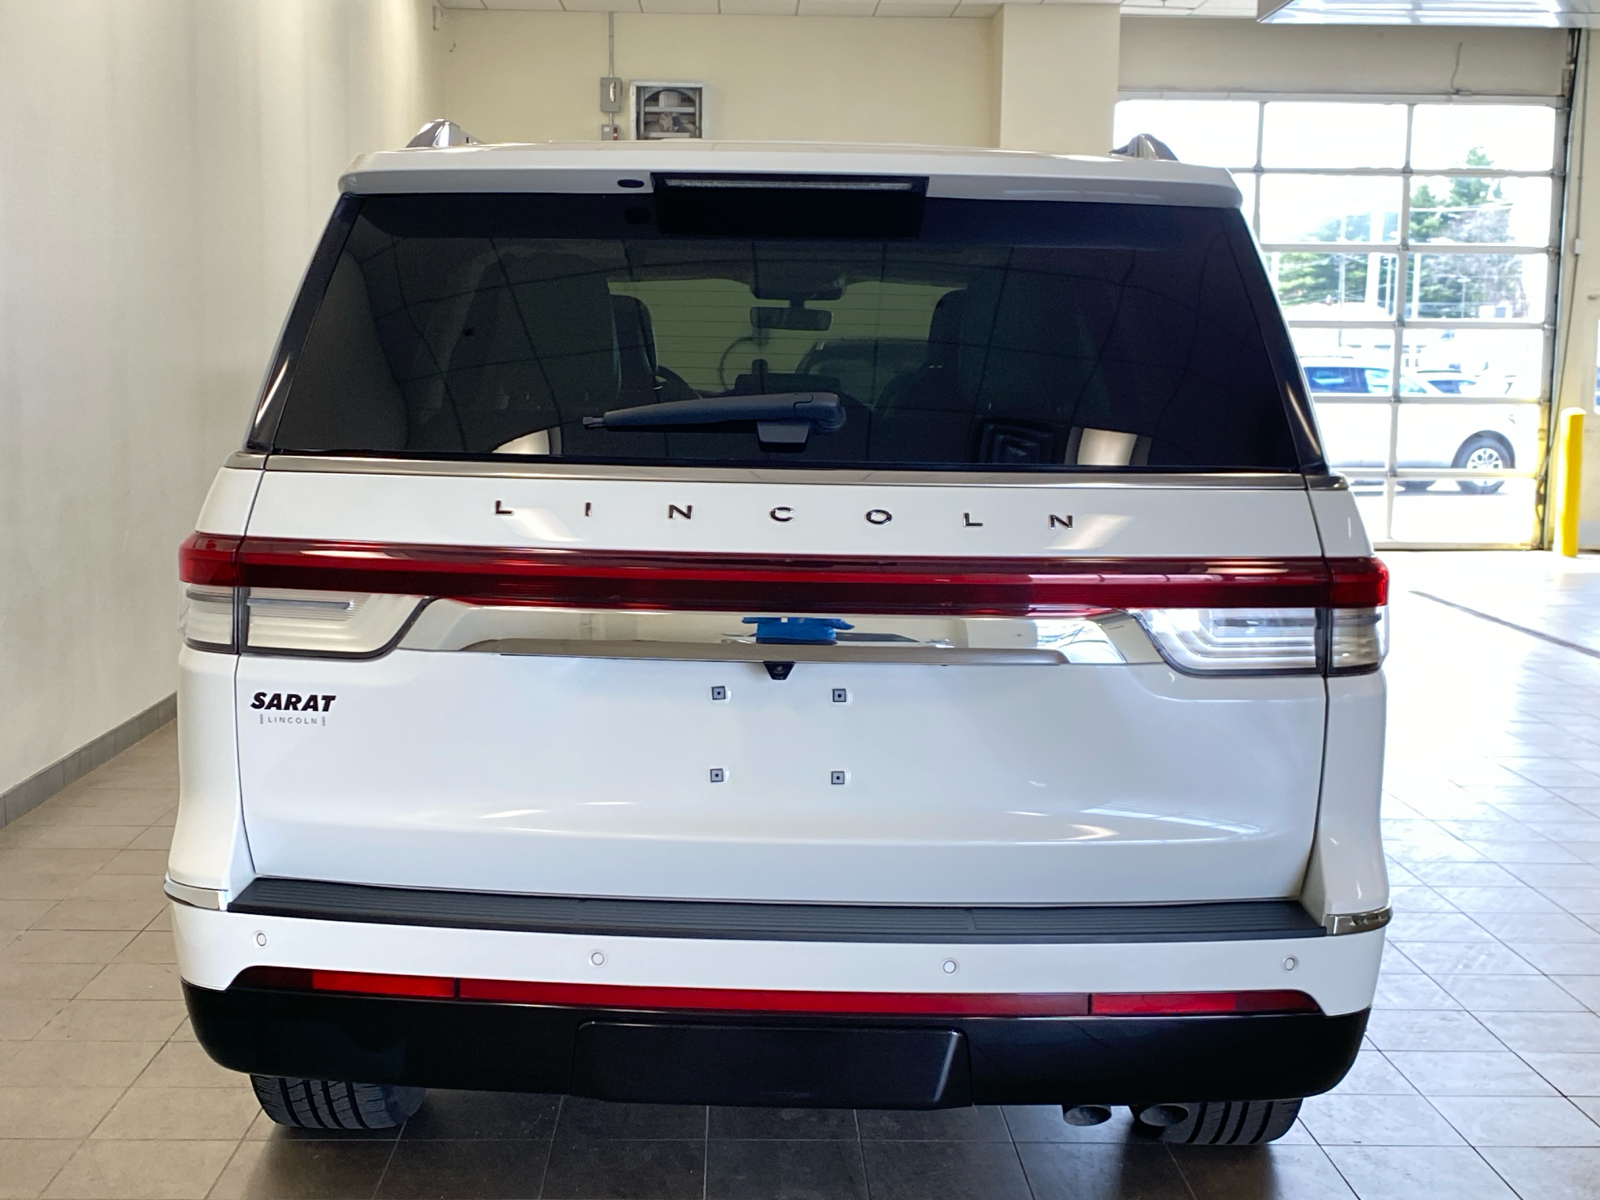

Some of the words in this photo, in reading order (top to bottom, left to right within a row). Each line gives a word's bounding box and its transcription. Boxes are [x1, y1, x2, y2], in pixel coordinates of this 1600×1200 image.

[494, 500, 1074, 530] LINCOLN
[250, 692, 337, 712] SARAT
[267, 716, 318, 725] LINCOLN
